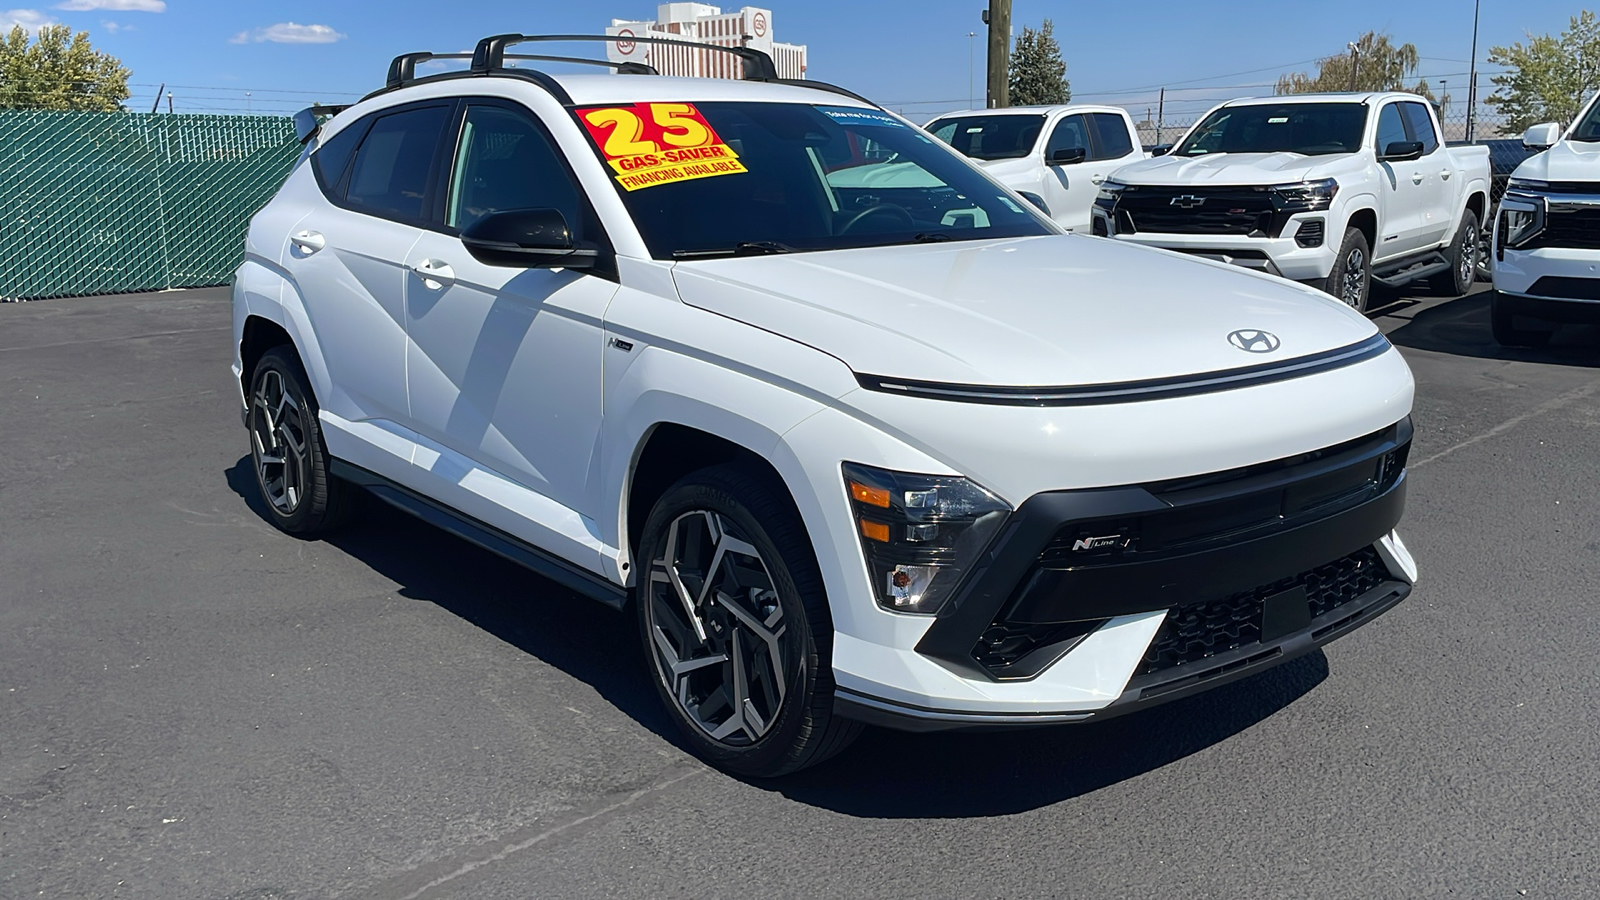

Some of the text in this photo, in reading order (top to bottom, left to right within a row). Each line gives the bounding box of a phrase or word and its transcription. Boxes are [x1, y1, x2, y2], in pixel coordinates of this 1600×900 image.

[585, 103, 714, 157] 25
[619, 146, 726, 171] GAS-SAVER
[621, 161, 742, 189] FINANCING AVAILABLE
[1072, 537, 1092, 550] N
